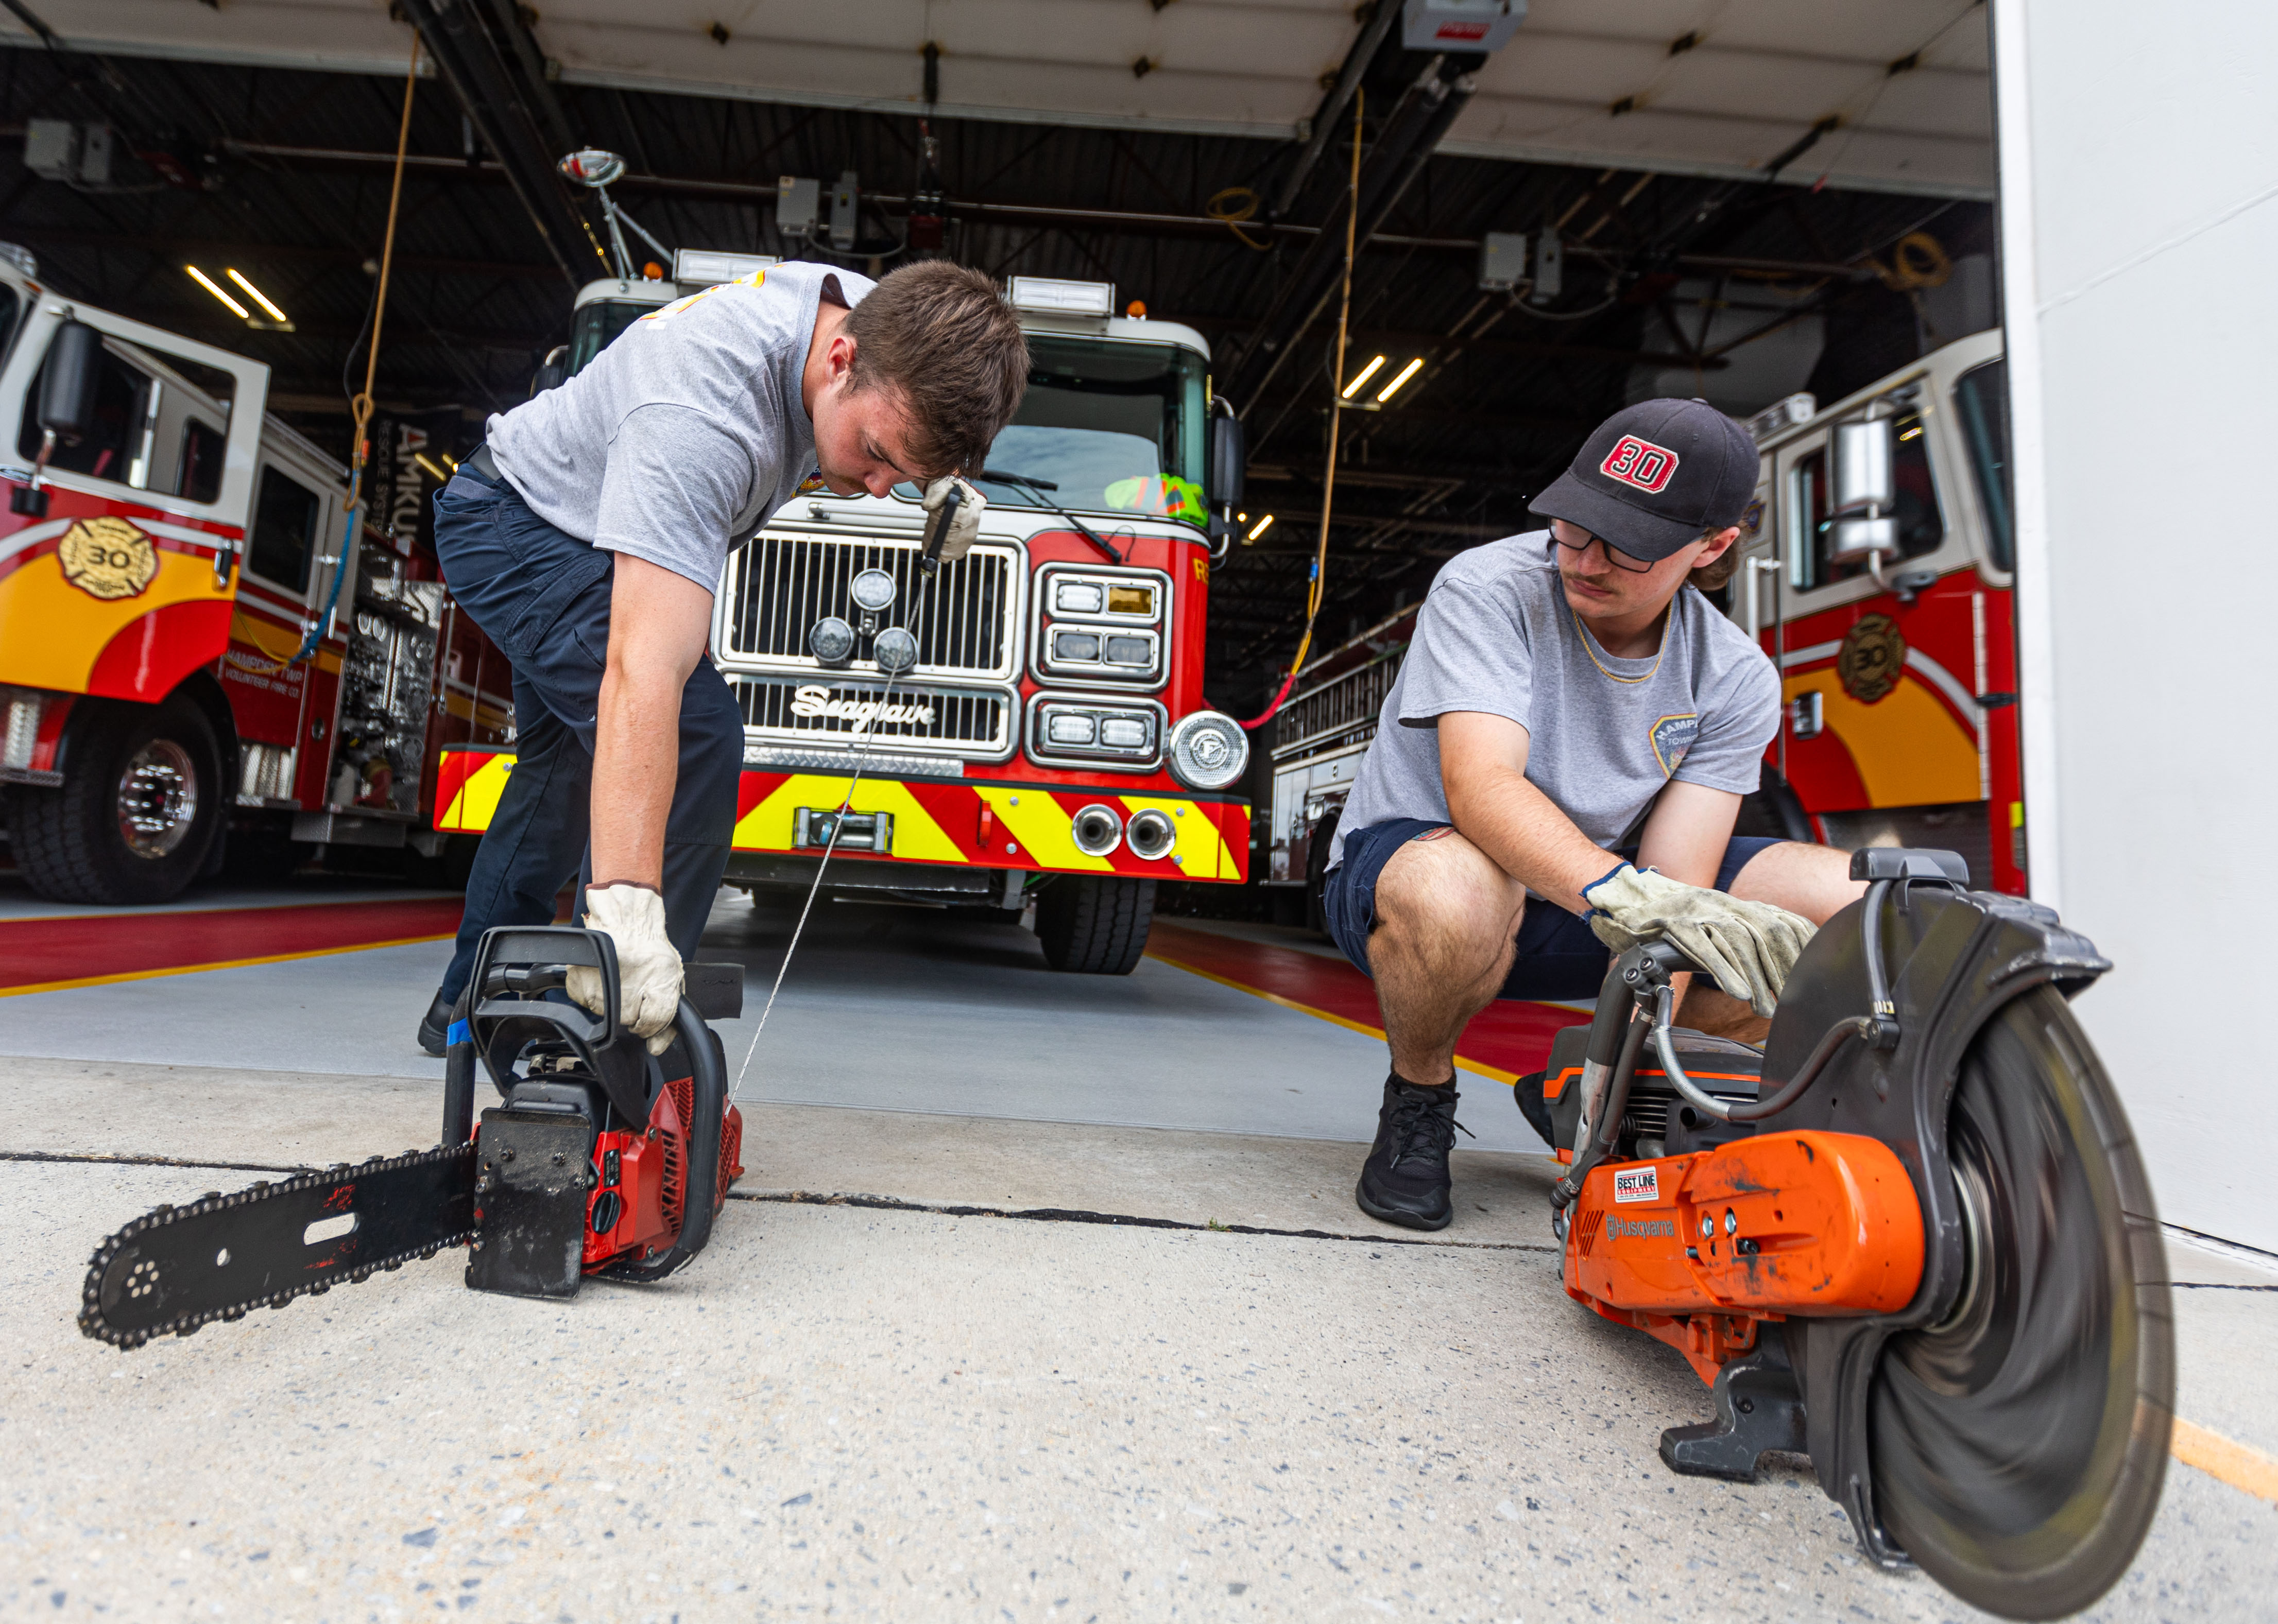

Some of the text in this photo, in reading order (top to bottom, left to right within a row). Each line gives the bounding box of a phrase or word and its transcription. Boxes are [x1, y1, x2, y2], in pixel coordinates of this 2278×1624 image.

[1611, 442, 1668, 485] 30
[87, 545, 130, 568] 30
[1858, 645, 1887, 670] 30
[225, 667, 269, 690] VOLUNTEER
[270, 681, 288, 695] FIRE
[790, 684, 936, 734] Seagrave
[1656, 719, 1698, 740] HAMP
[1618, 1174, 1655, 1189] BEST LINE
[1618, 1186, 1655, 1195] EQUIPMENT
[1616, 1217, 1674, 1240] Husqvarna
